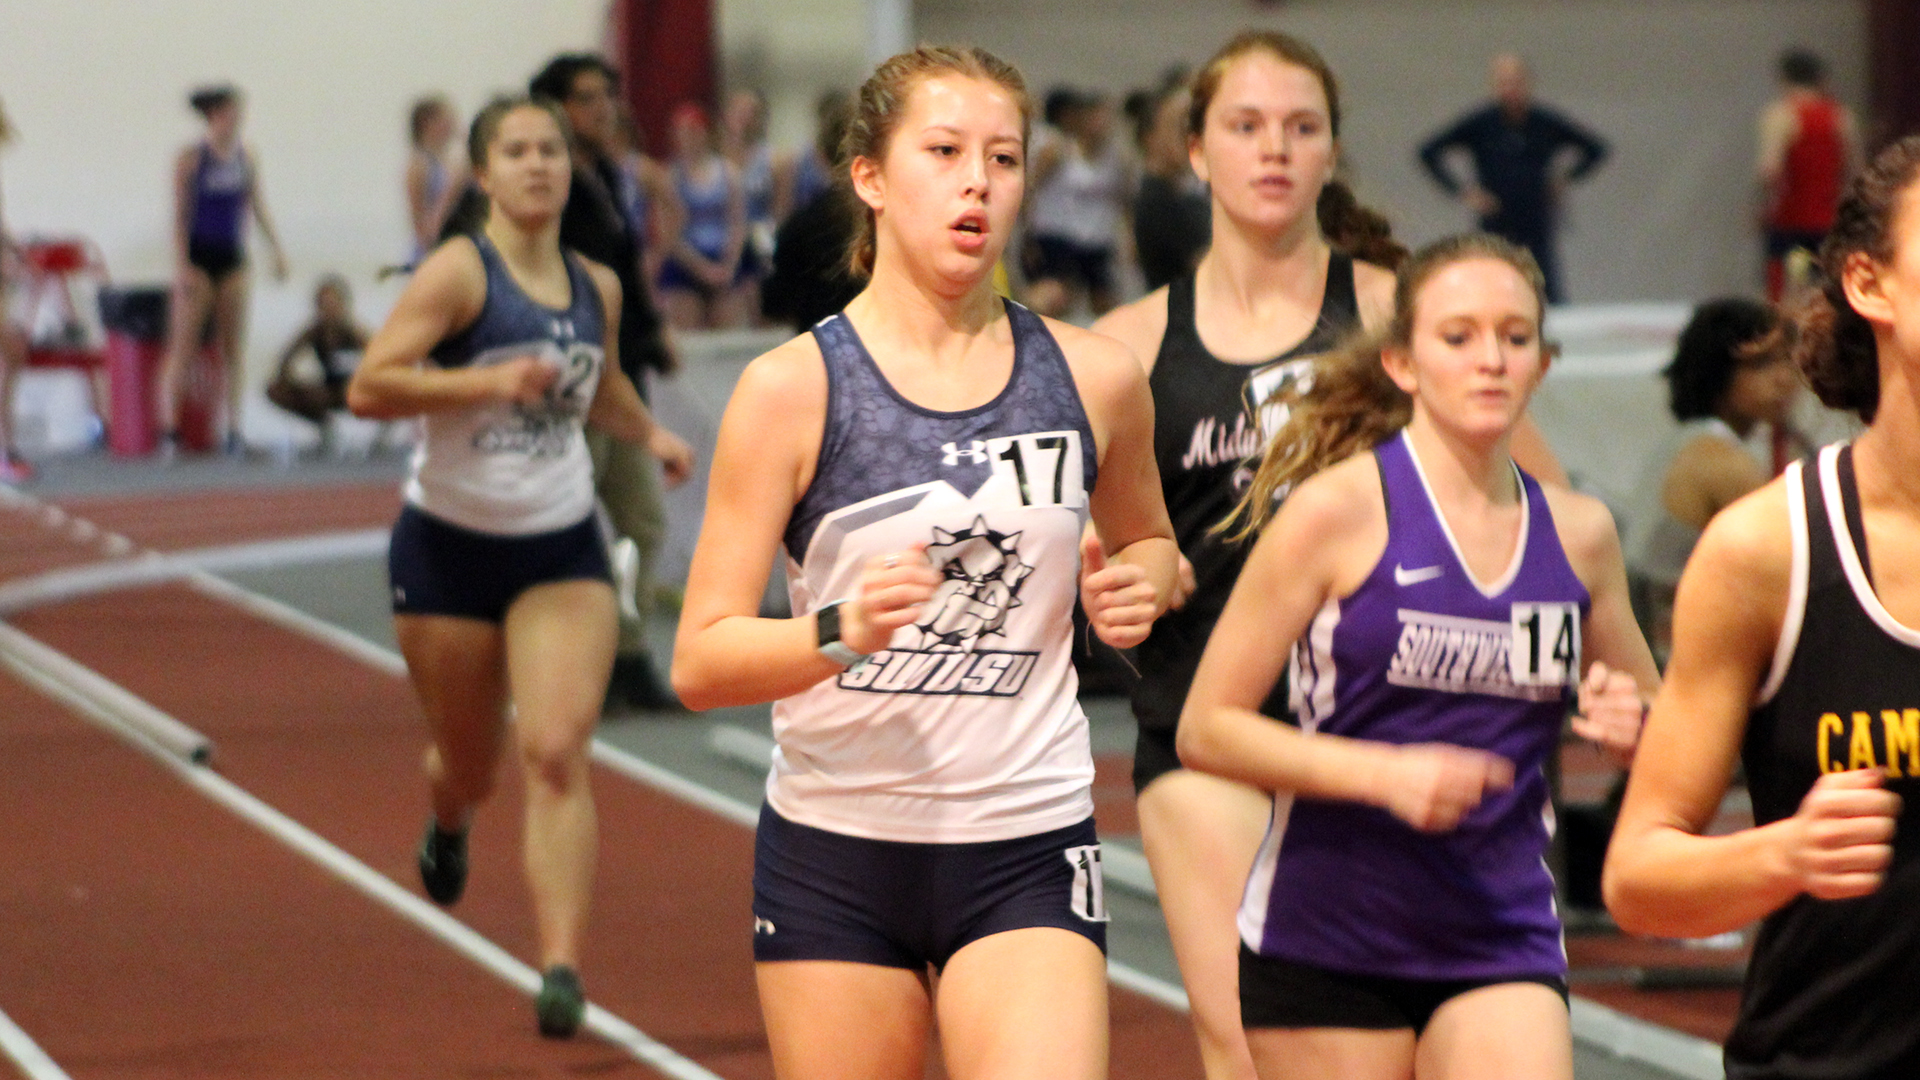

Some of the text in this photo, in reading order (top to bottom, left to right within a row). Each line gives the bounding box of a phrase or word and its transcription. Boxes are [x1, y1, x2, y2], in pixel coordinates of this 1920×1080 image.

[999, 437, 1069, 506] 17
[1518, 613, 1574, 676] 14
[1817, 708, 1920, 778] CAM
